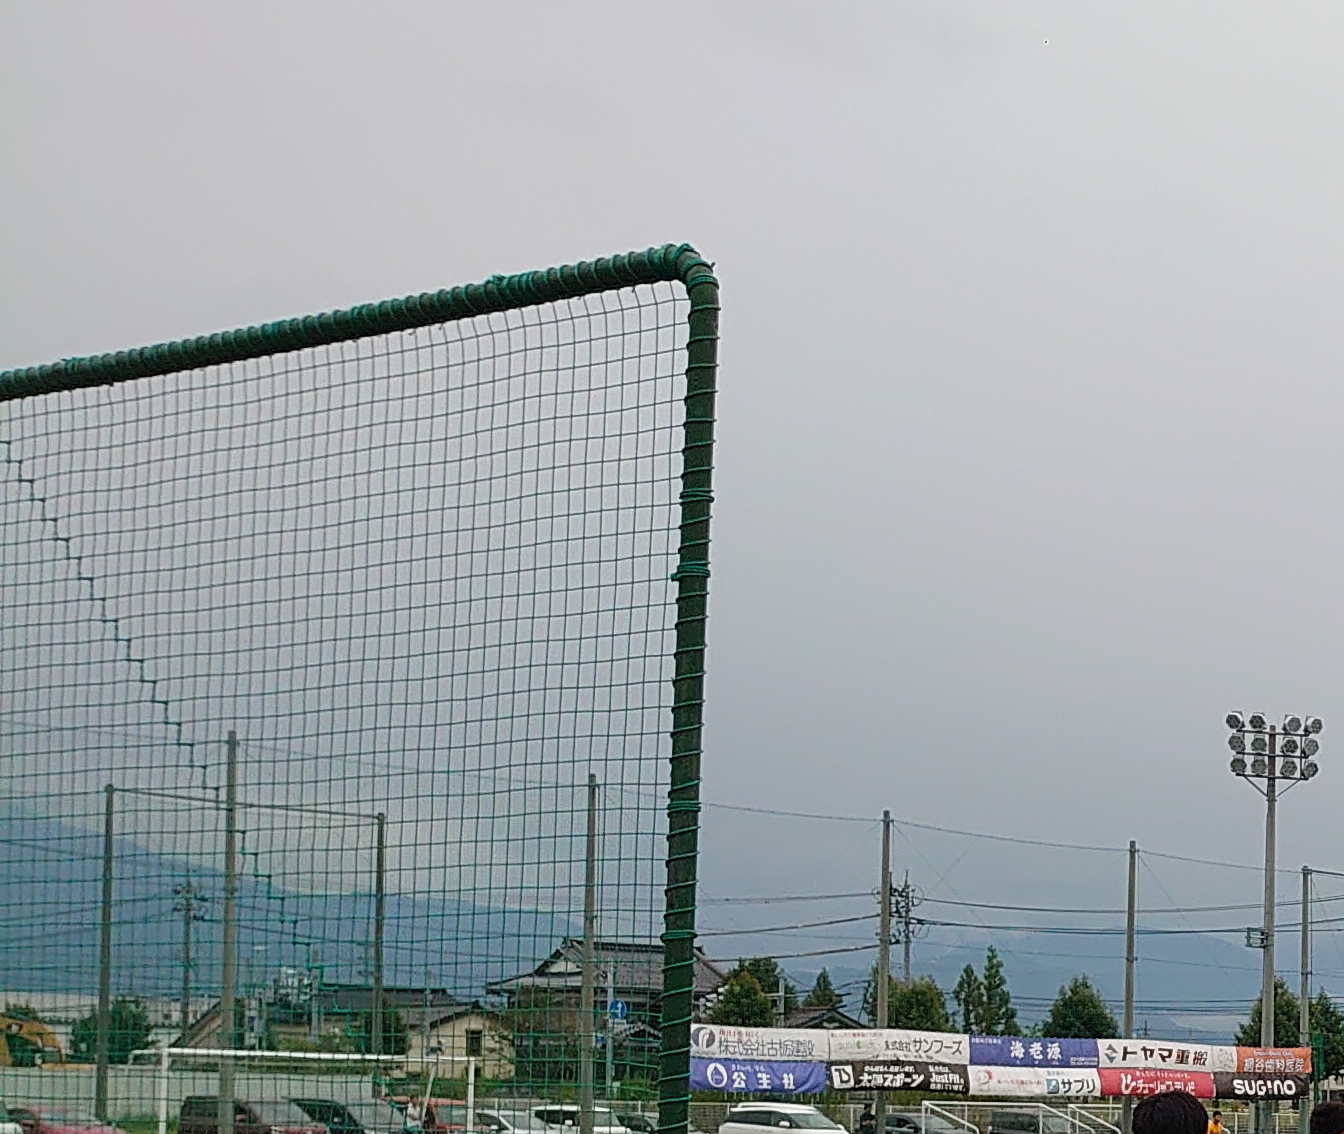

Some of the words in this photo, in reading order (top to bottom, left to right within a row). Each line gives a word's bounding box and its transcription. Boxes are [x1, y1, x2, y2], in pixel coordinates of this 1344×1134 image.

[1010, 1041, 1062, 1060] 海老源
[1061, 1078, 1096, 1095] サプリ
